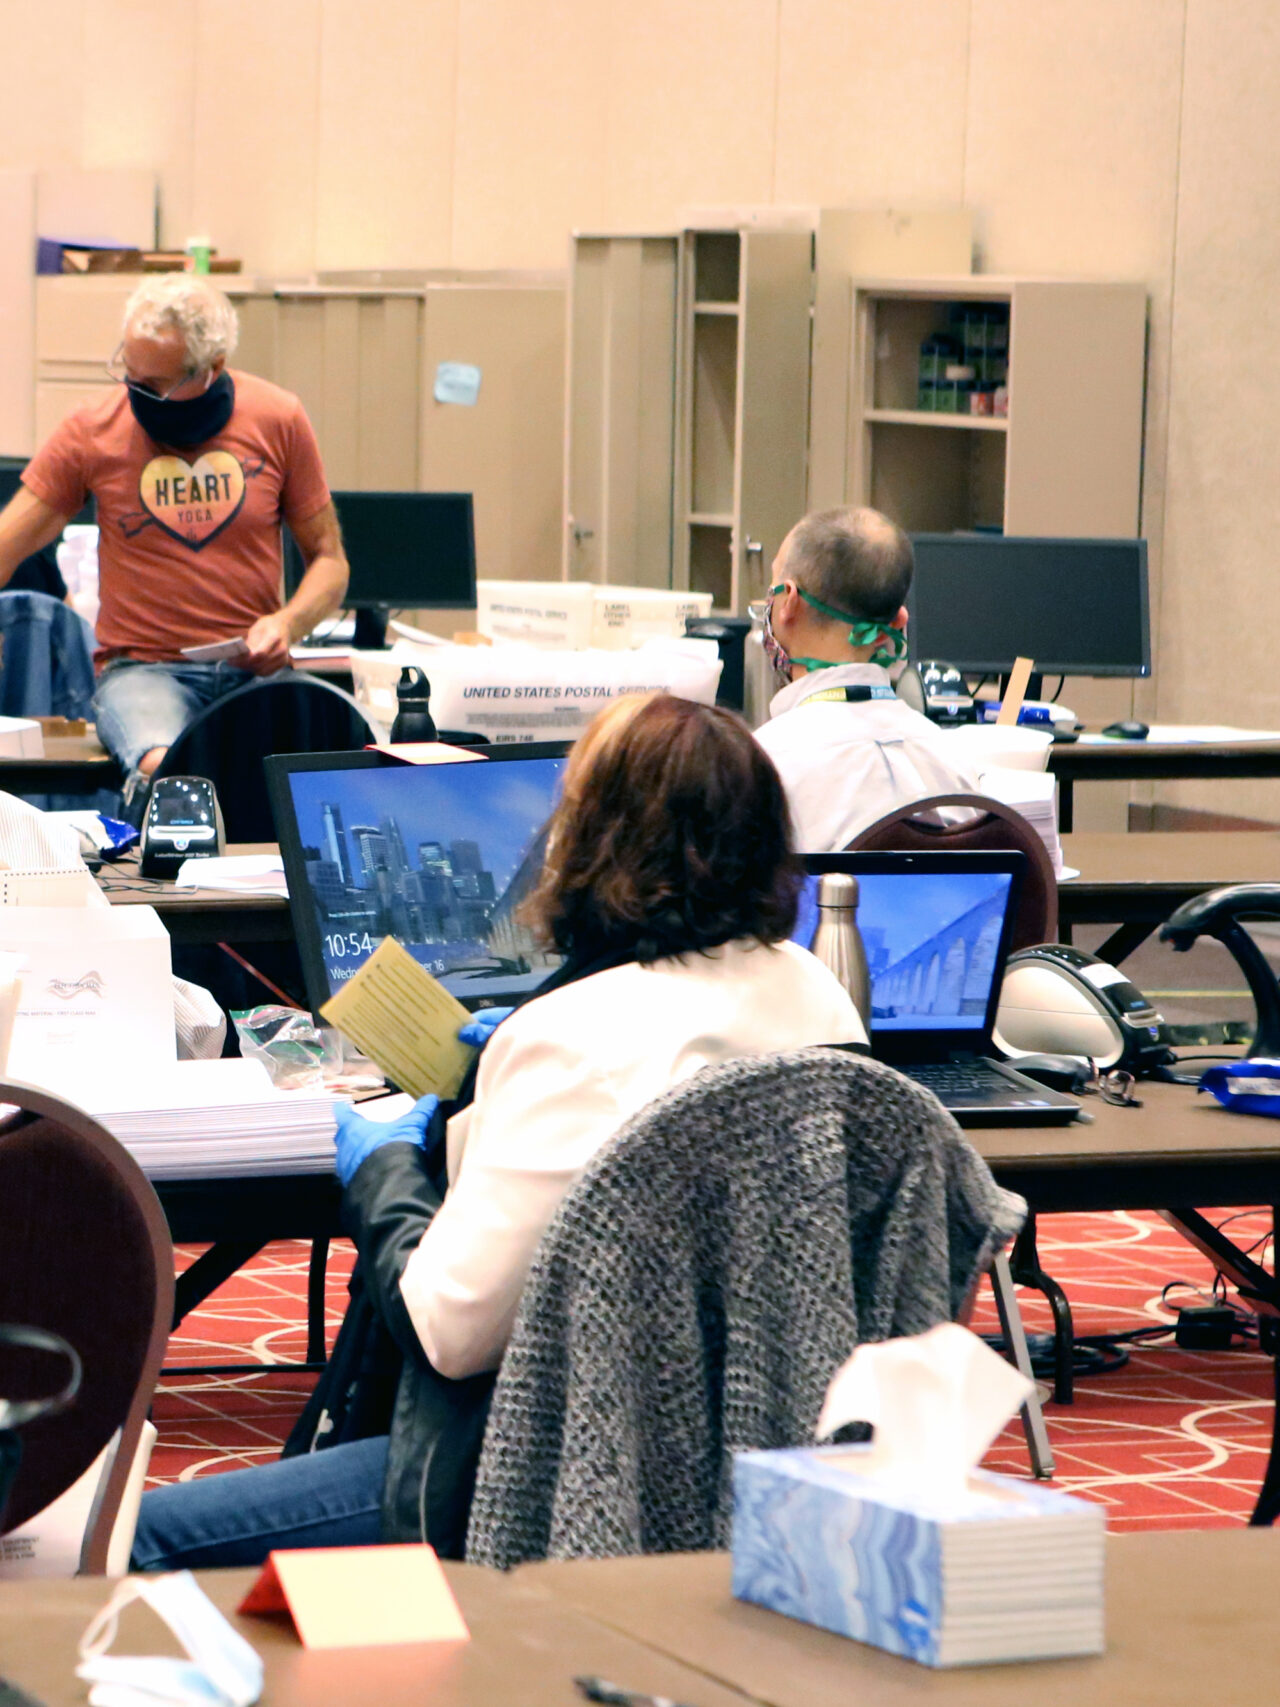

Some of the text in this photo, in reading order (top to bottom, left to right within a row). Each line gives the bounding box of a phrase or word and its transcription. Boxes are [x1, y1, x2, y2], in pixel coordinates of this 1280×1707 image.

[156, 474, 231, 506] HEART
[178, 509, 213, 523] YOGA
[463, 687, 511, 698] UNITED
[513, 687, 561, 698] STATES
[564, 686, 613, 697] POSTAL
[325, 932, 373, 957] 10:54
[436, 960, 445, 970] 16
